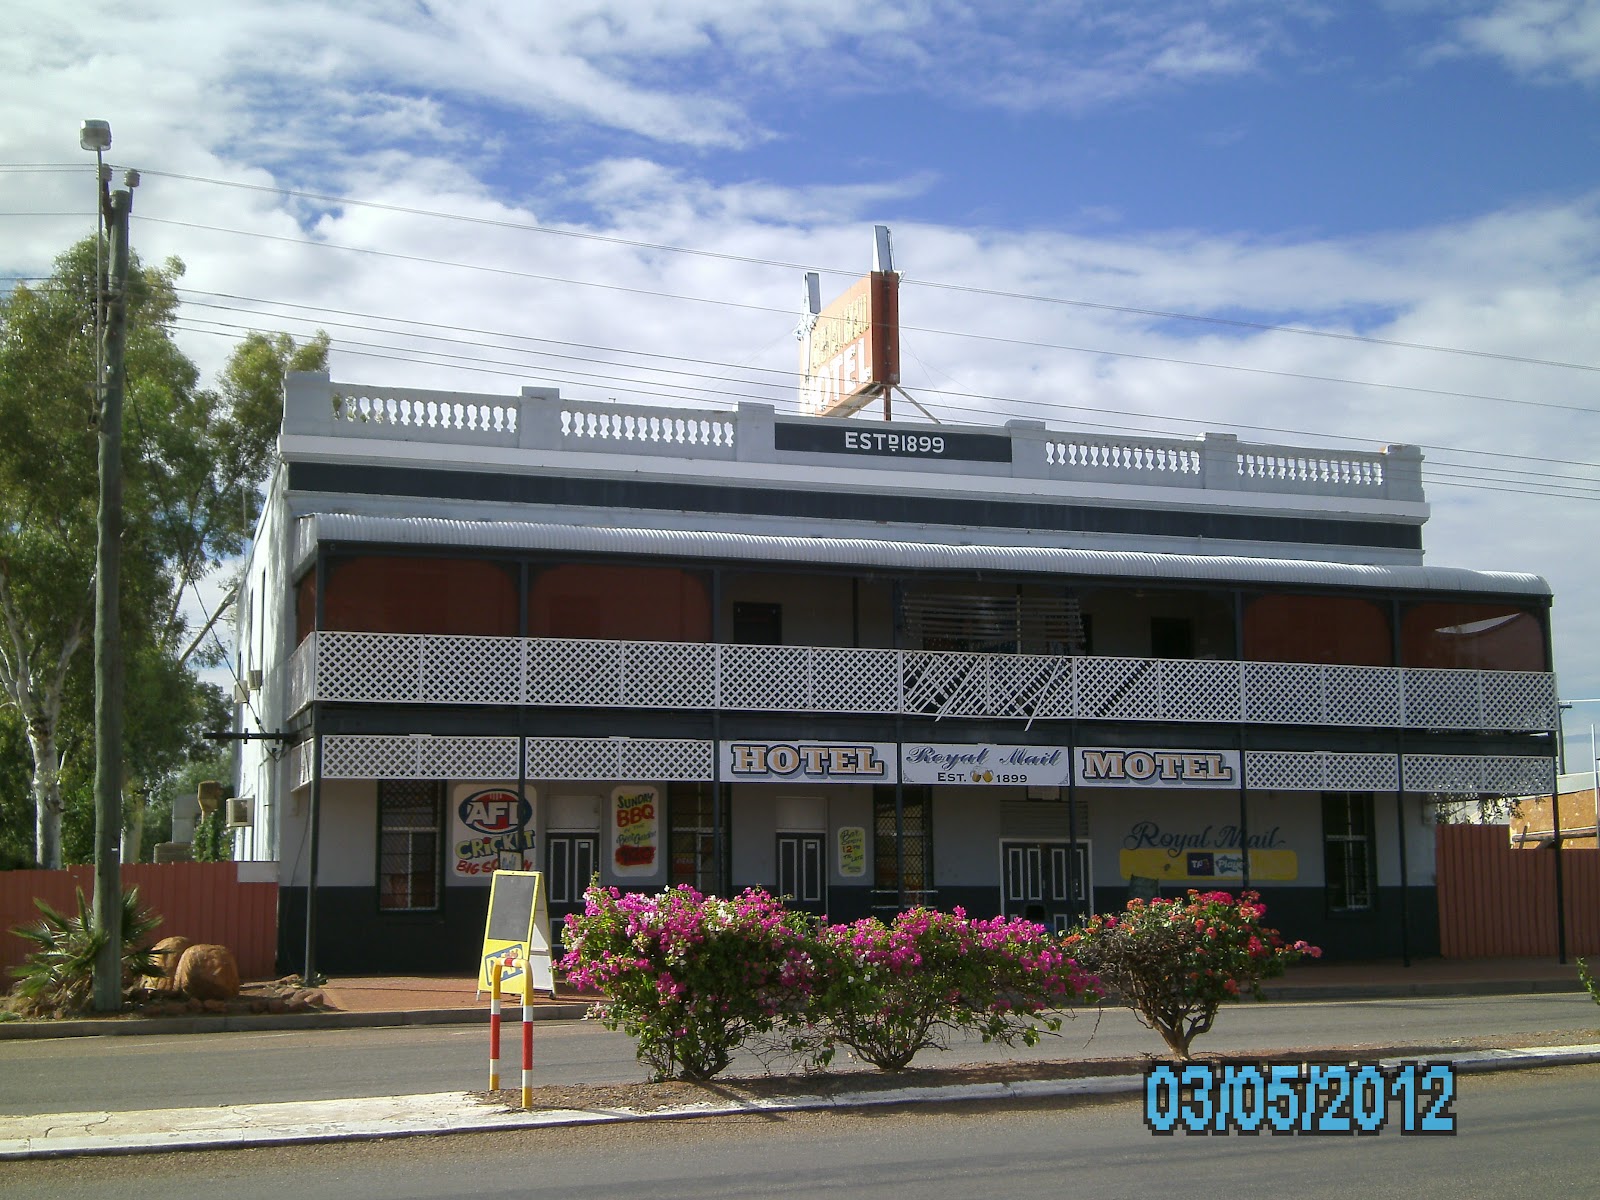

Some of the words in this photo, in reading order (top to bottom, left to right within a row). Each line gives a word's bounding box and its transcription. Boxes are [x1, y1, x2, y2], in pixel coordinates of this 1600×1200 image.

[801, 337, 873, 414] OTEL
[731, 744, 887, 778] HOTEL
[906, 745, 990, 771] Royal
[1000, 748, 1062, 766] Mail
[1082, 750, 1235, 784] MOTEL
[937, 772, 967, 783] EST.
[996, 774, 1028, 783] 1899
[617, 793, 654, 809] SUNDAY
[616, 804, 655, 828] BBQ
[1123, 821, 1214, 858] Royal
[1214, 825, 1286, 848] Mail
[456, 860, 480, 874] BIG
